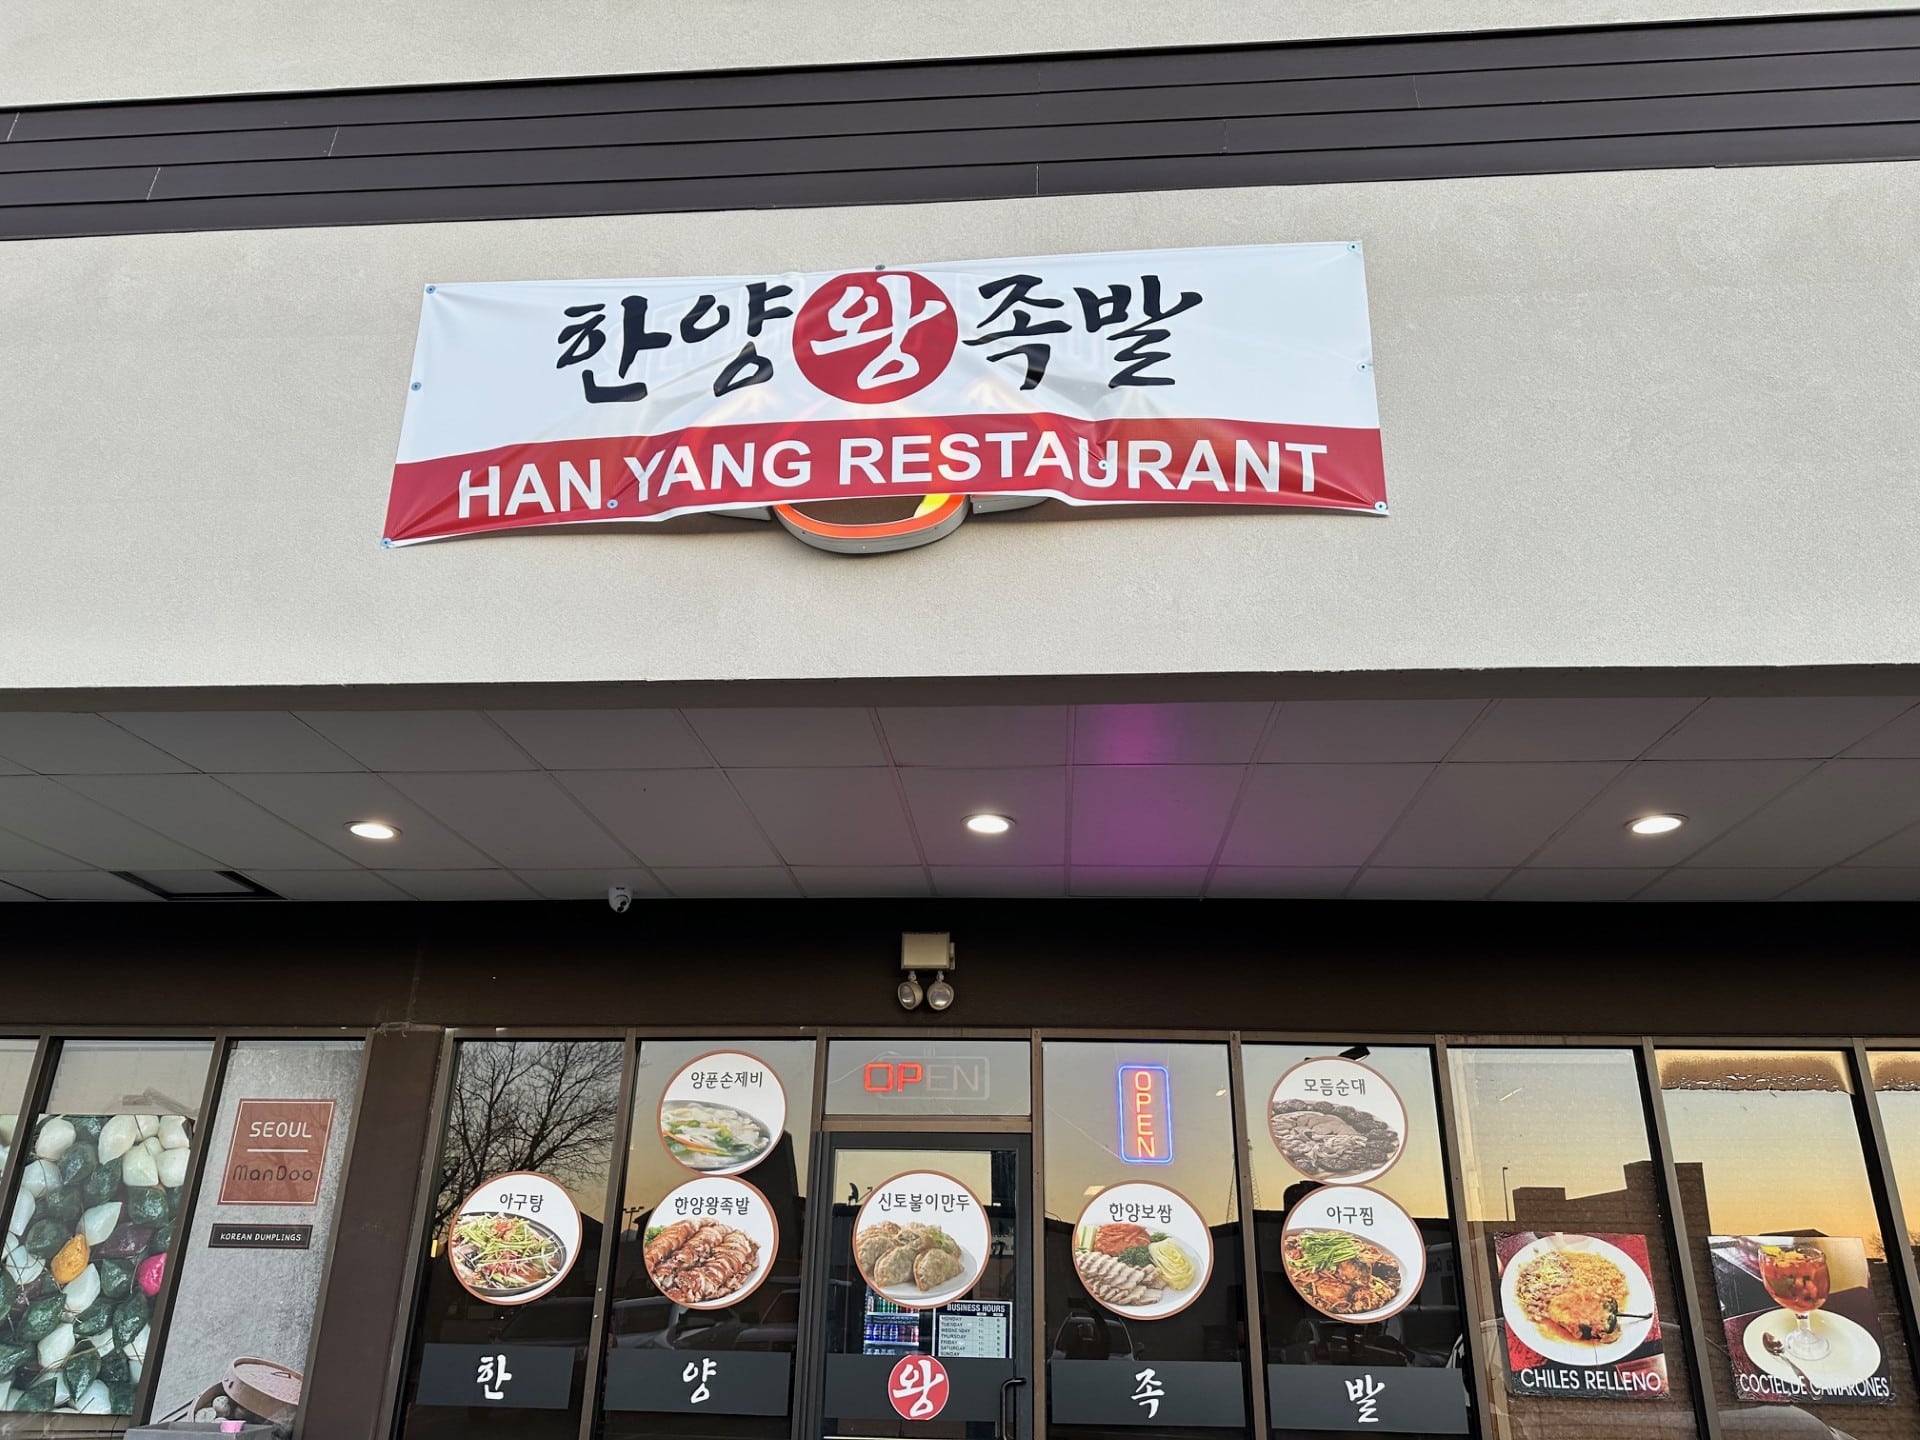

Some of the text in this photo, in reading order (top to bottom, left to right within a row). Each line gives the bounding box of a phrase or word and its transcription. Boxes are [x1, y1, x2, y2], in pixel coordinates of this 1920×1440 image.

[457, 430, 1328, 519] HAN YANG RESTAURANT
[690, 1071, 764, 1090] 양푼손제비
[864, 1061, 980, 1093] OPEN
[1304, 1078, 1367, 1096] 모듬순대
[1134, 1070, 1156, 1158] OPEN
[249, 1121, 313, 1138] SEOUL
[499, 1193, 545, 1213] 아구탕
[674, 1196, 751, 1216] 한양왕족발
[878, 1192, 970, 1213] 신토불이만두
[1109, 1202, 1173, 1224] 한양보쌈
[1326, 1206, 1375, 1227] 아구찜
[219, 1232, 302, 1242] KOREAN DUMPLINGS
[946, 1303, 1006, 1313] BUSINESS HOURS
[476, 1354, 513, 1400] 한
[682, 1357, 718, 1404] 양
[1520, 1368, 1661, 1392] CHILES RELLENO
[1791, 1376, 1808, 1395] DE
[892, 1359, 945, 1418] 왕
[1130, 1368, 1165, 1419] 족
[1344, 1374, 1386, 1424] 발
